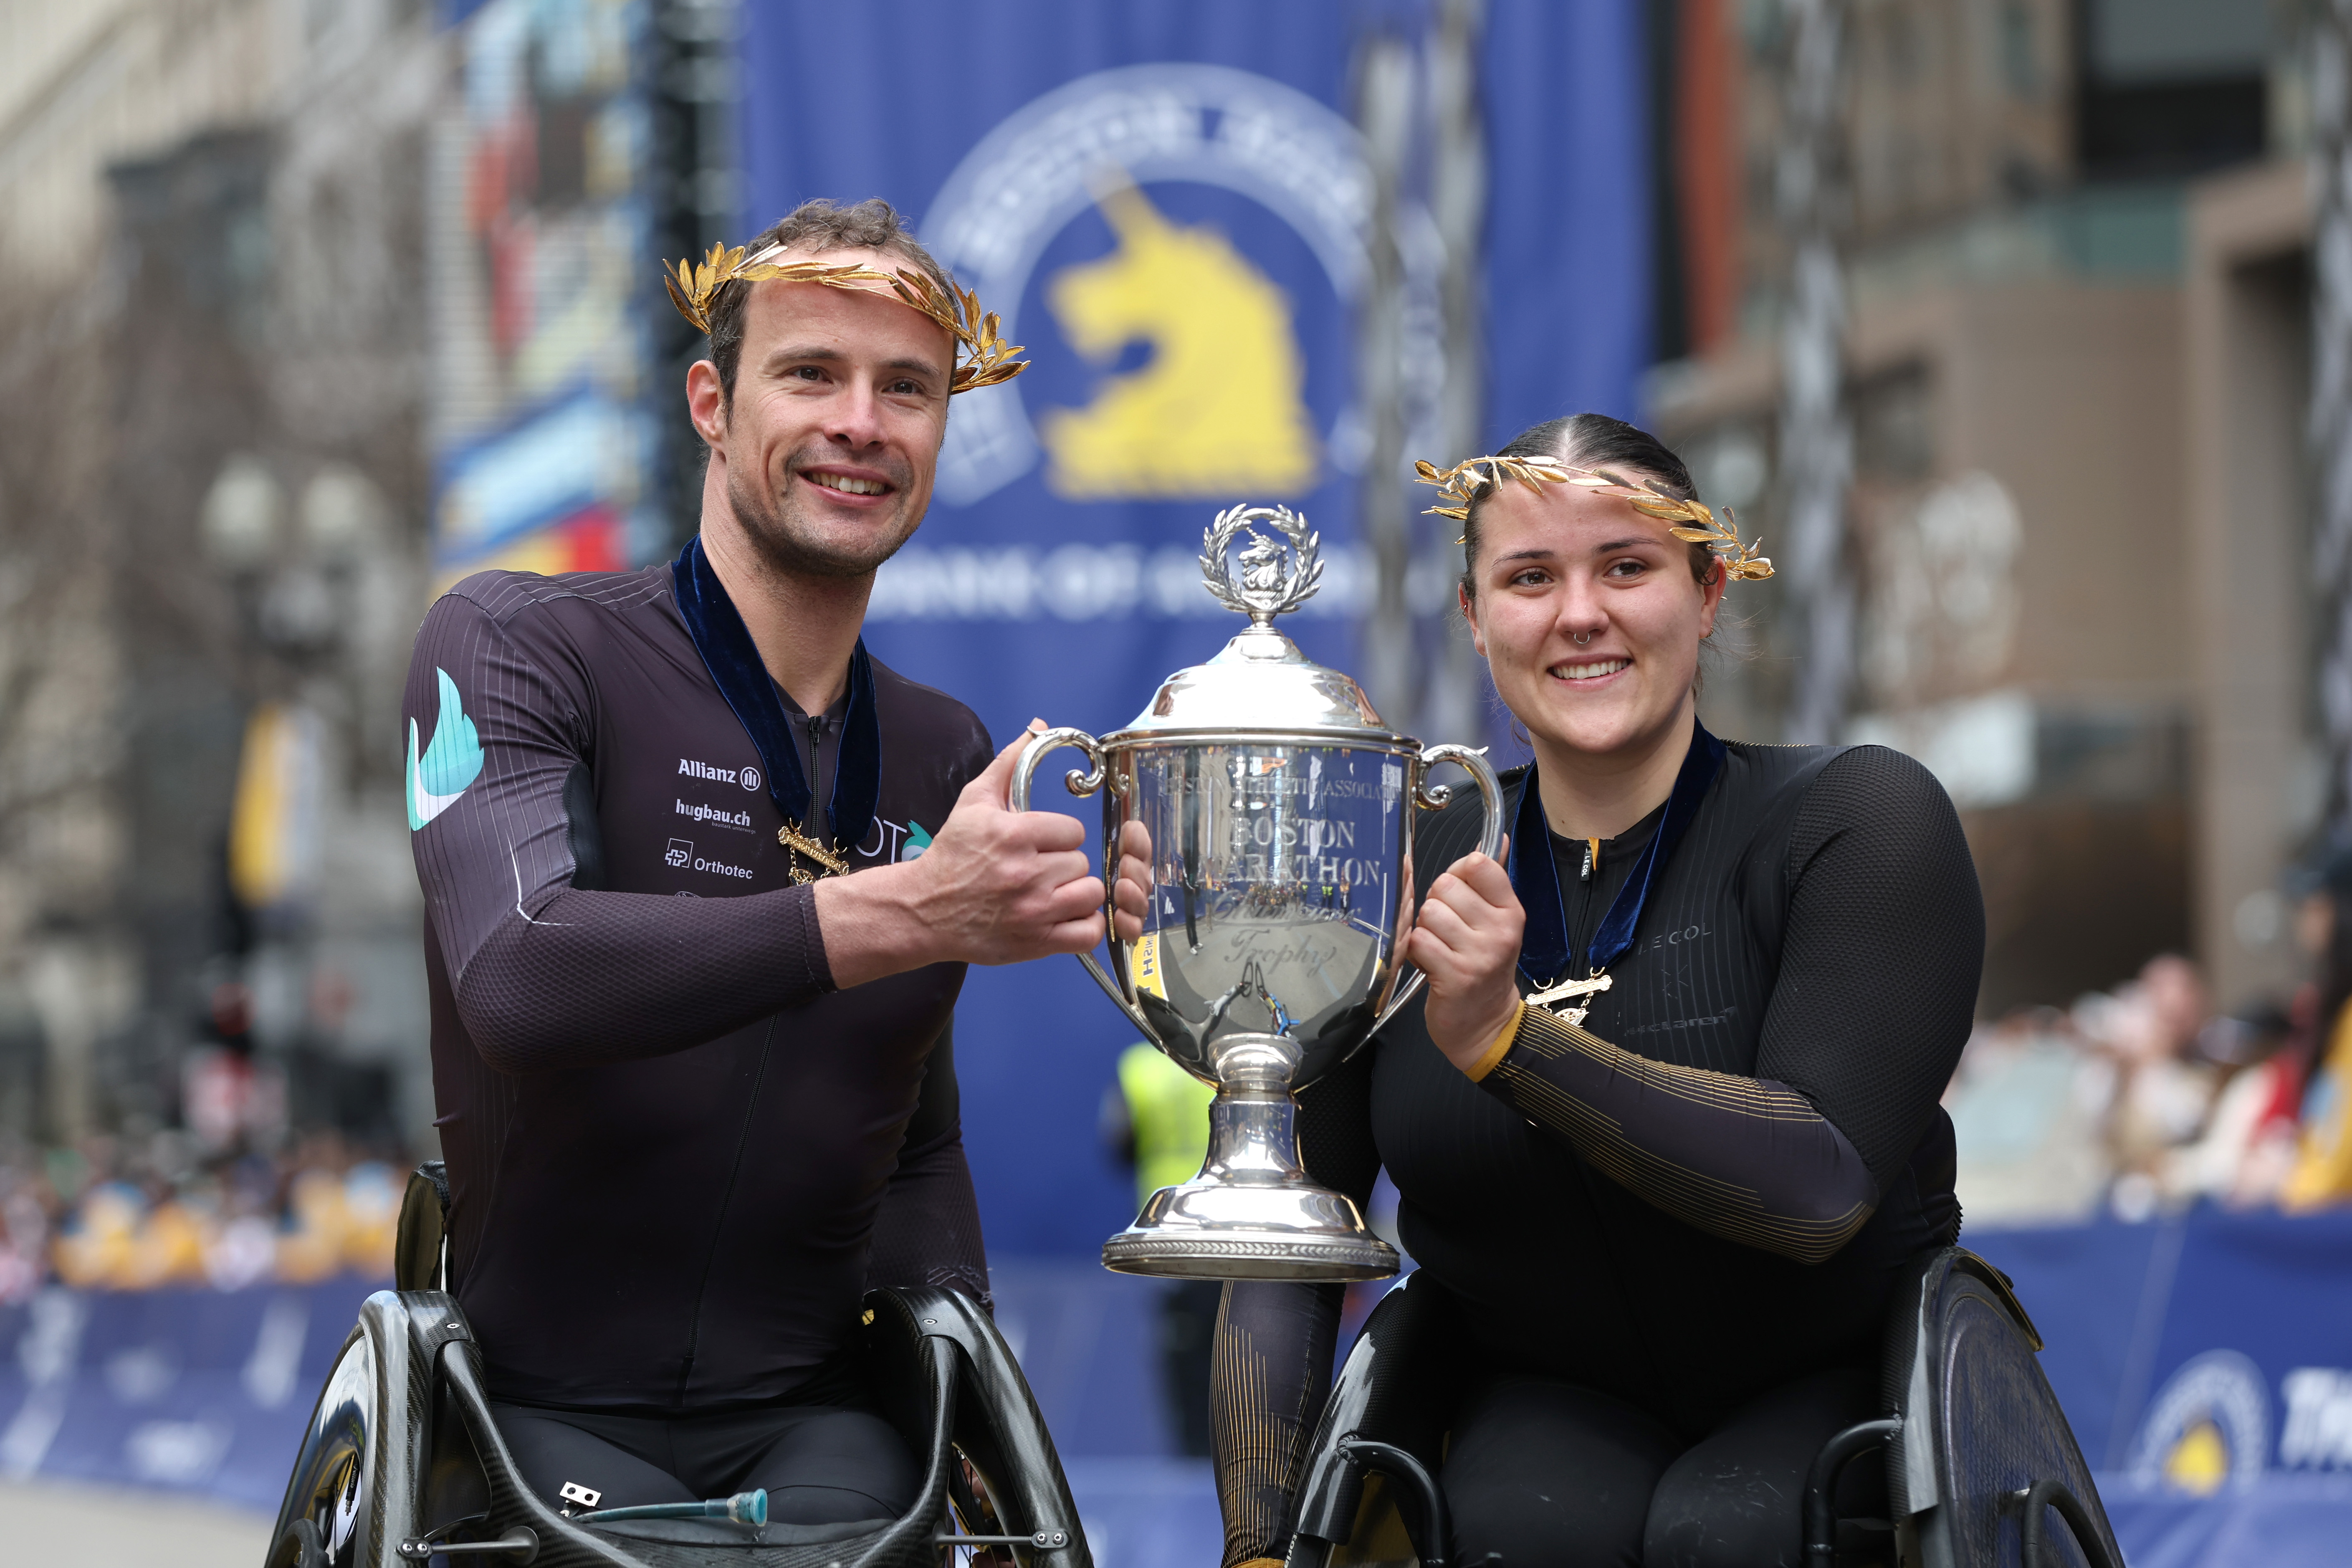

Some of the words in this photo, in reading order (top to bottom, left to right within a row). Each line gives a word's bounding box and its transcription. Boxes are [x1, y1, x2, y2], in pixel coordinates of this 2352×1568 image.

[678, 759, 736, 784] Allianz
[675, 799, 750, 827] hugbau.ch
[732, 826, 756, 834] unterwegs
[1230, 816, 1356, 848] BOSTON
[695, 858, 753, 879] Orthotec
[1197, 854, 1380, 886] MARATHON
[1668, 922, 1712, 945] COL
[1224, 929, 1336, 978] Trophy
[1284, 1533, 1297, 1568] toria
